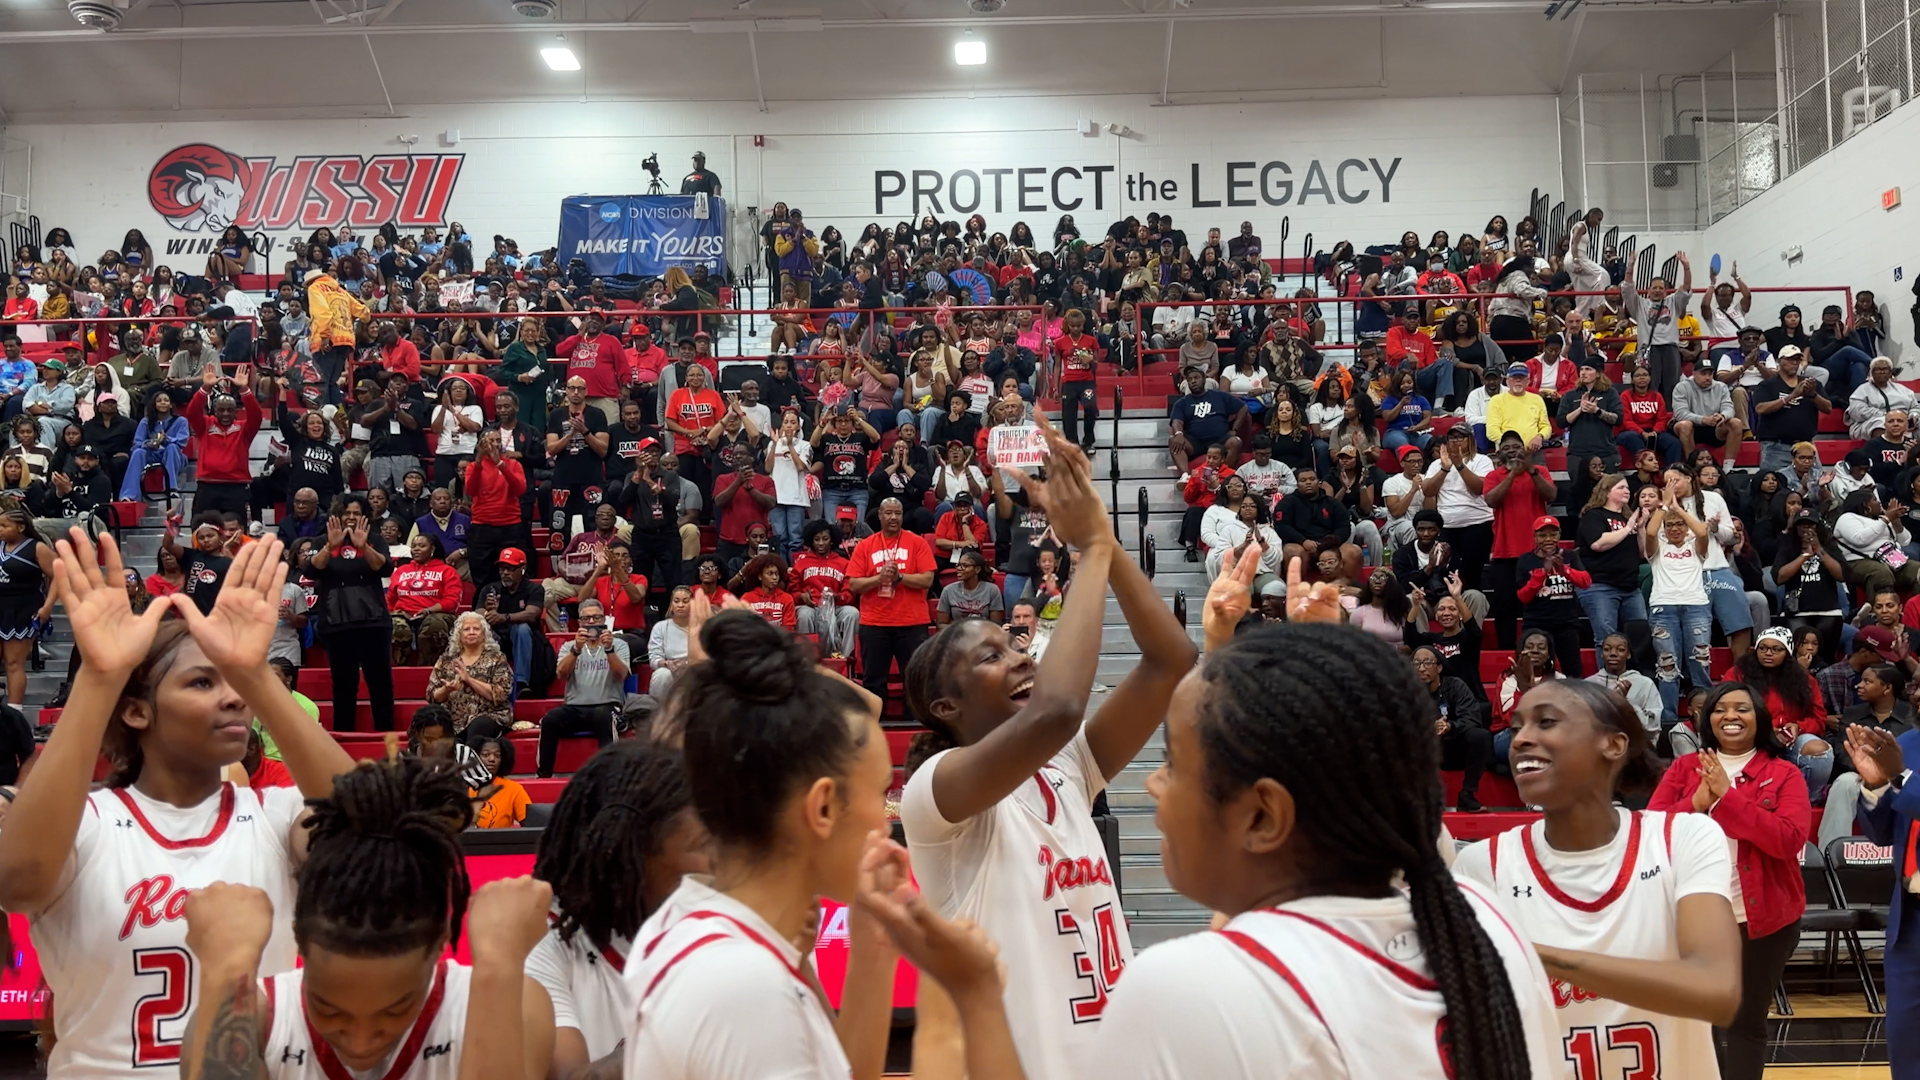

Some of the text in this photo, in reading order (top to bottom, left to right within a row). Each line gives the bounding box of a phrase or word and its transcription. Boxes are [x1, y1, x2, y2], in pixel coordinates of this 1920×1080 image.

[240, 153, 466, 230] WSSU
[875, 157, 1402, 214] PROTECT the LEGACY
[602, 209, 621, 218] NCAA
[629, 207, 692, 219] DIVISION
[576, 228, 724, 262] MAKE IT YOURS
[1630, 401, 1658, 414] WSSU
[997, 452, 1044, 463] GO RAM
[1843, 842, 1894, 860] WSSU
[1640, 864, 1661, 880] CIAA
[119, 874, 193, 941] Ra
[1055, 902, 1126, 1025] 34
[132, 946, 193, 1069] 2
[1562, 1021, 1662, 1080] 13
